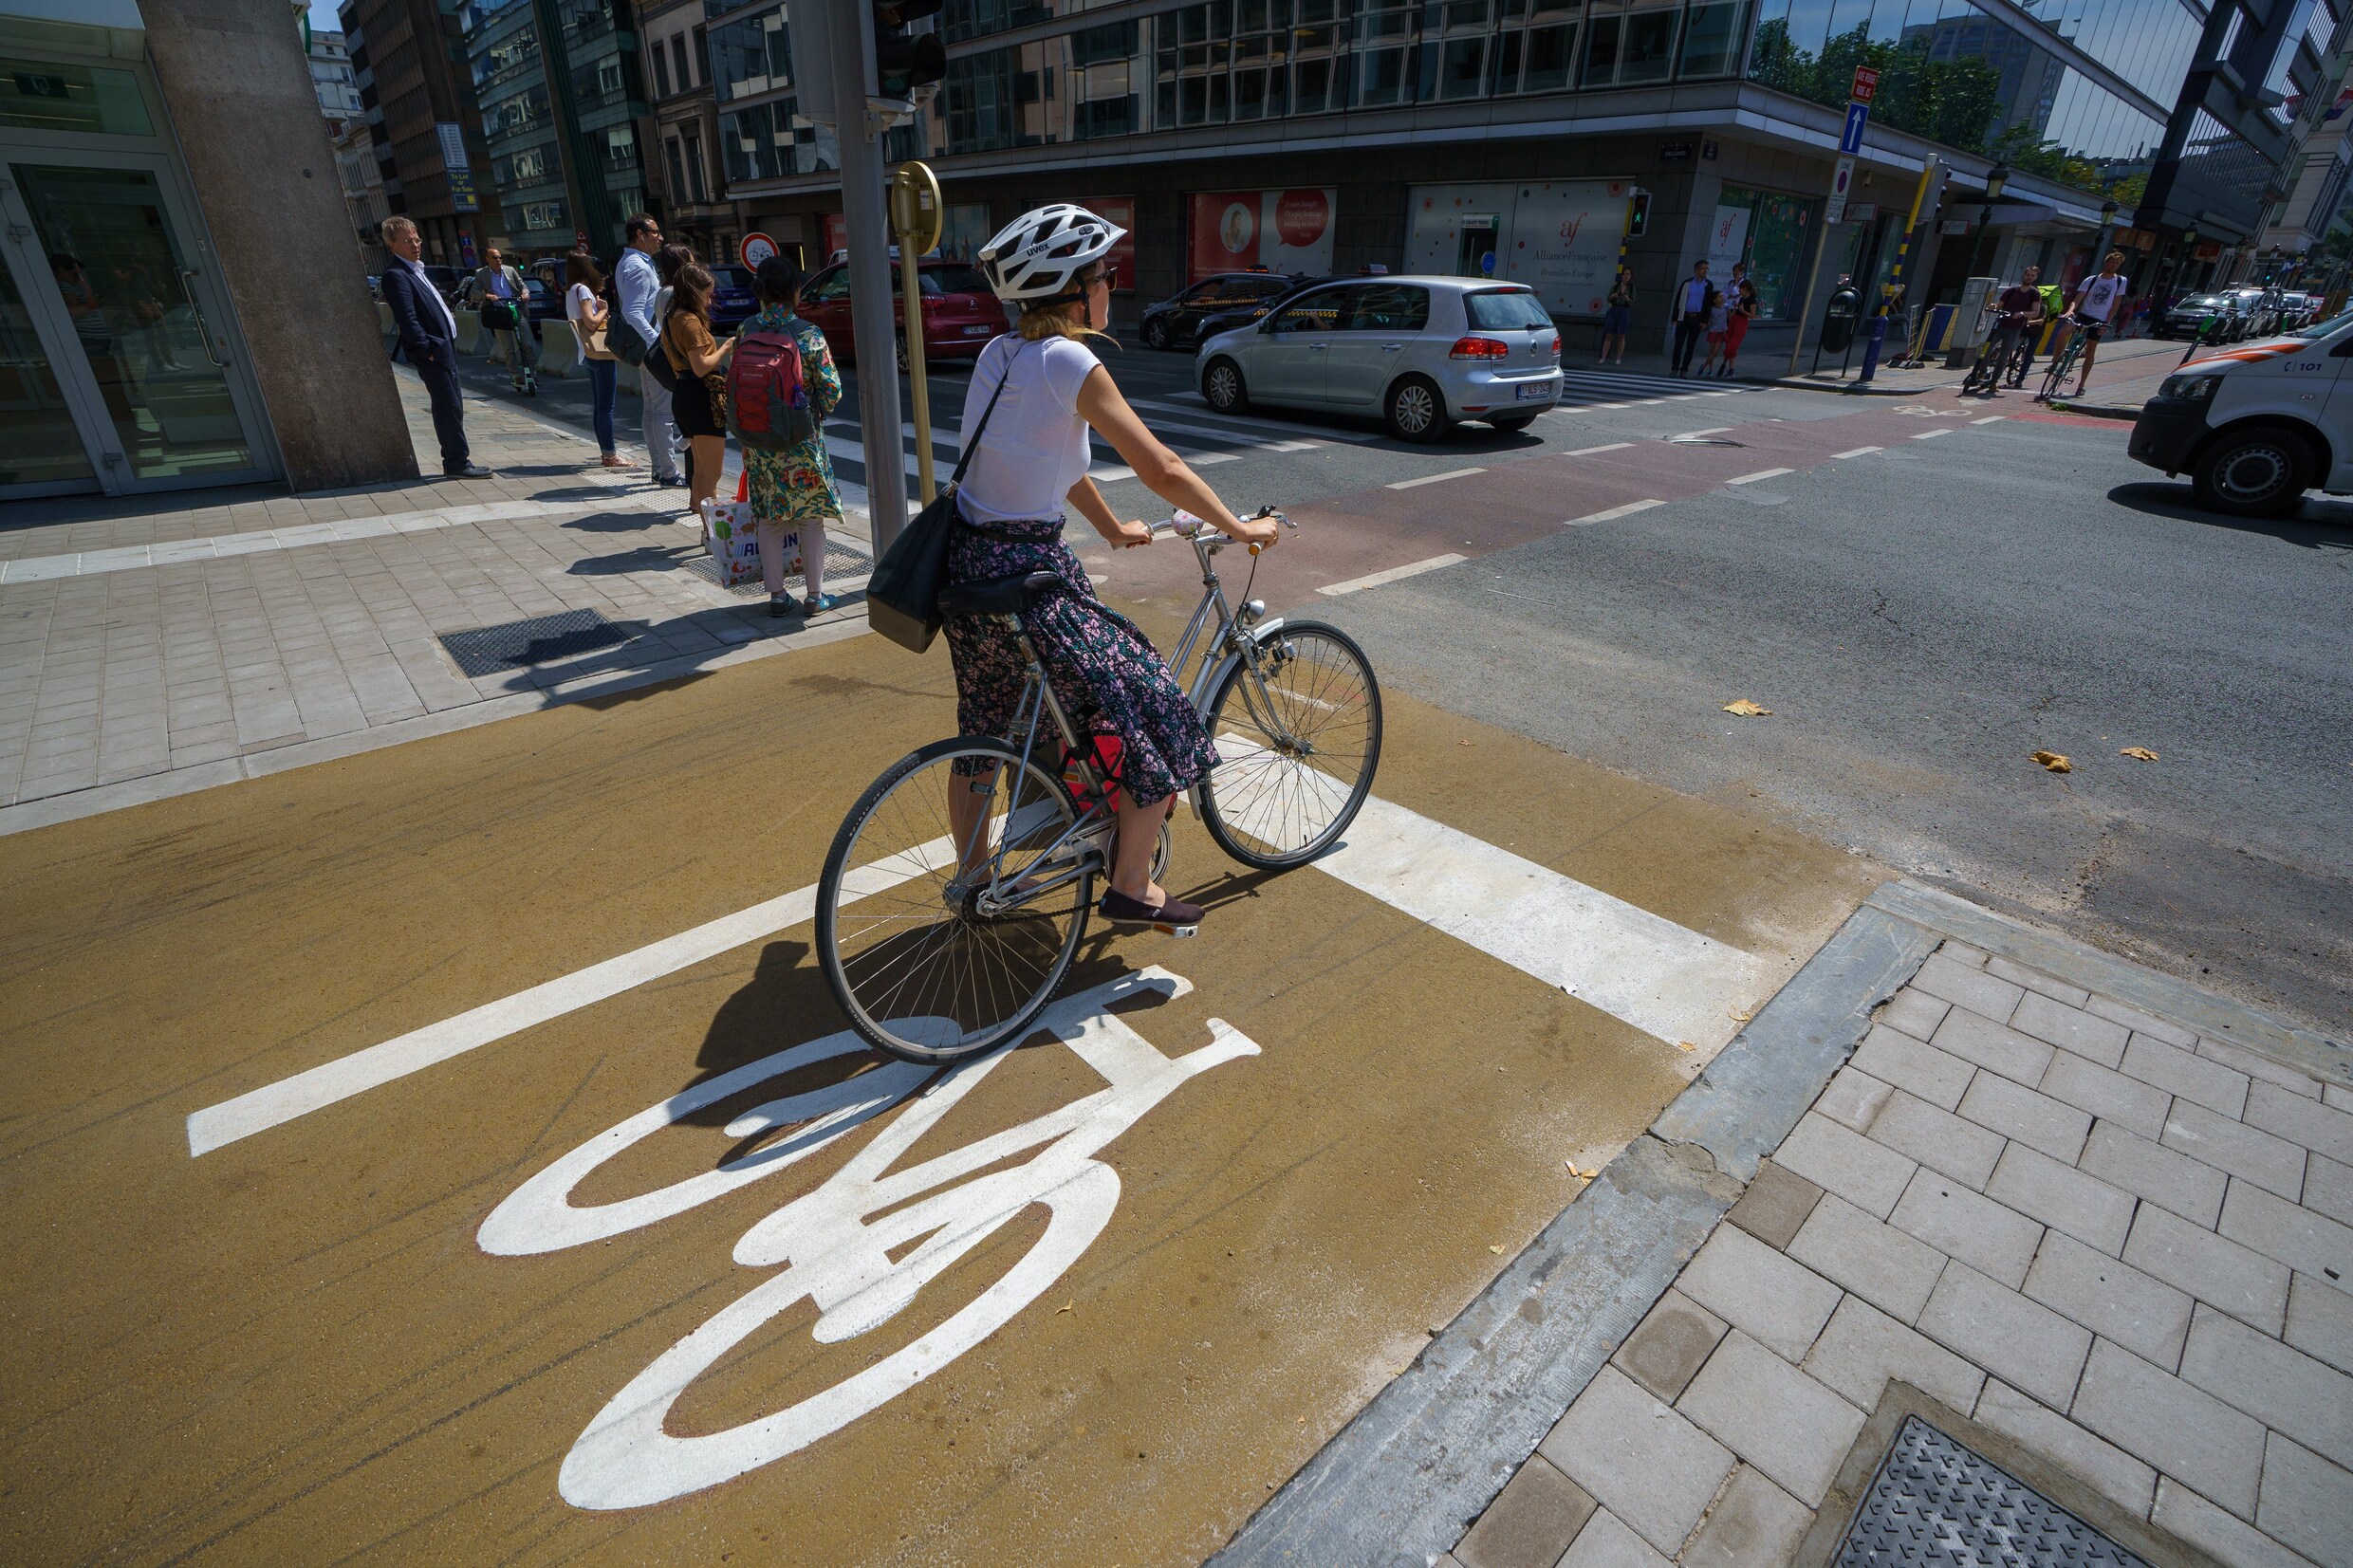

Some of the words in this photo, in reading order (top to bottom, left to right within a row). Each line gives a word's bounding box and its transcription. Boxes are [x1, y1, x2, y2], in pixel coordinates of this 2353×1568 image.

[1864, 72, 1877, 84] ROUGE
[1855, 84, 1866, 97] RODE
[1027, 243, 1050, 256] uvex
[2299, 362, 2323, 371] 101
[852, 1012, 882, 1043] MARATHON
